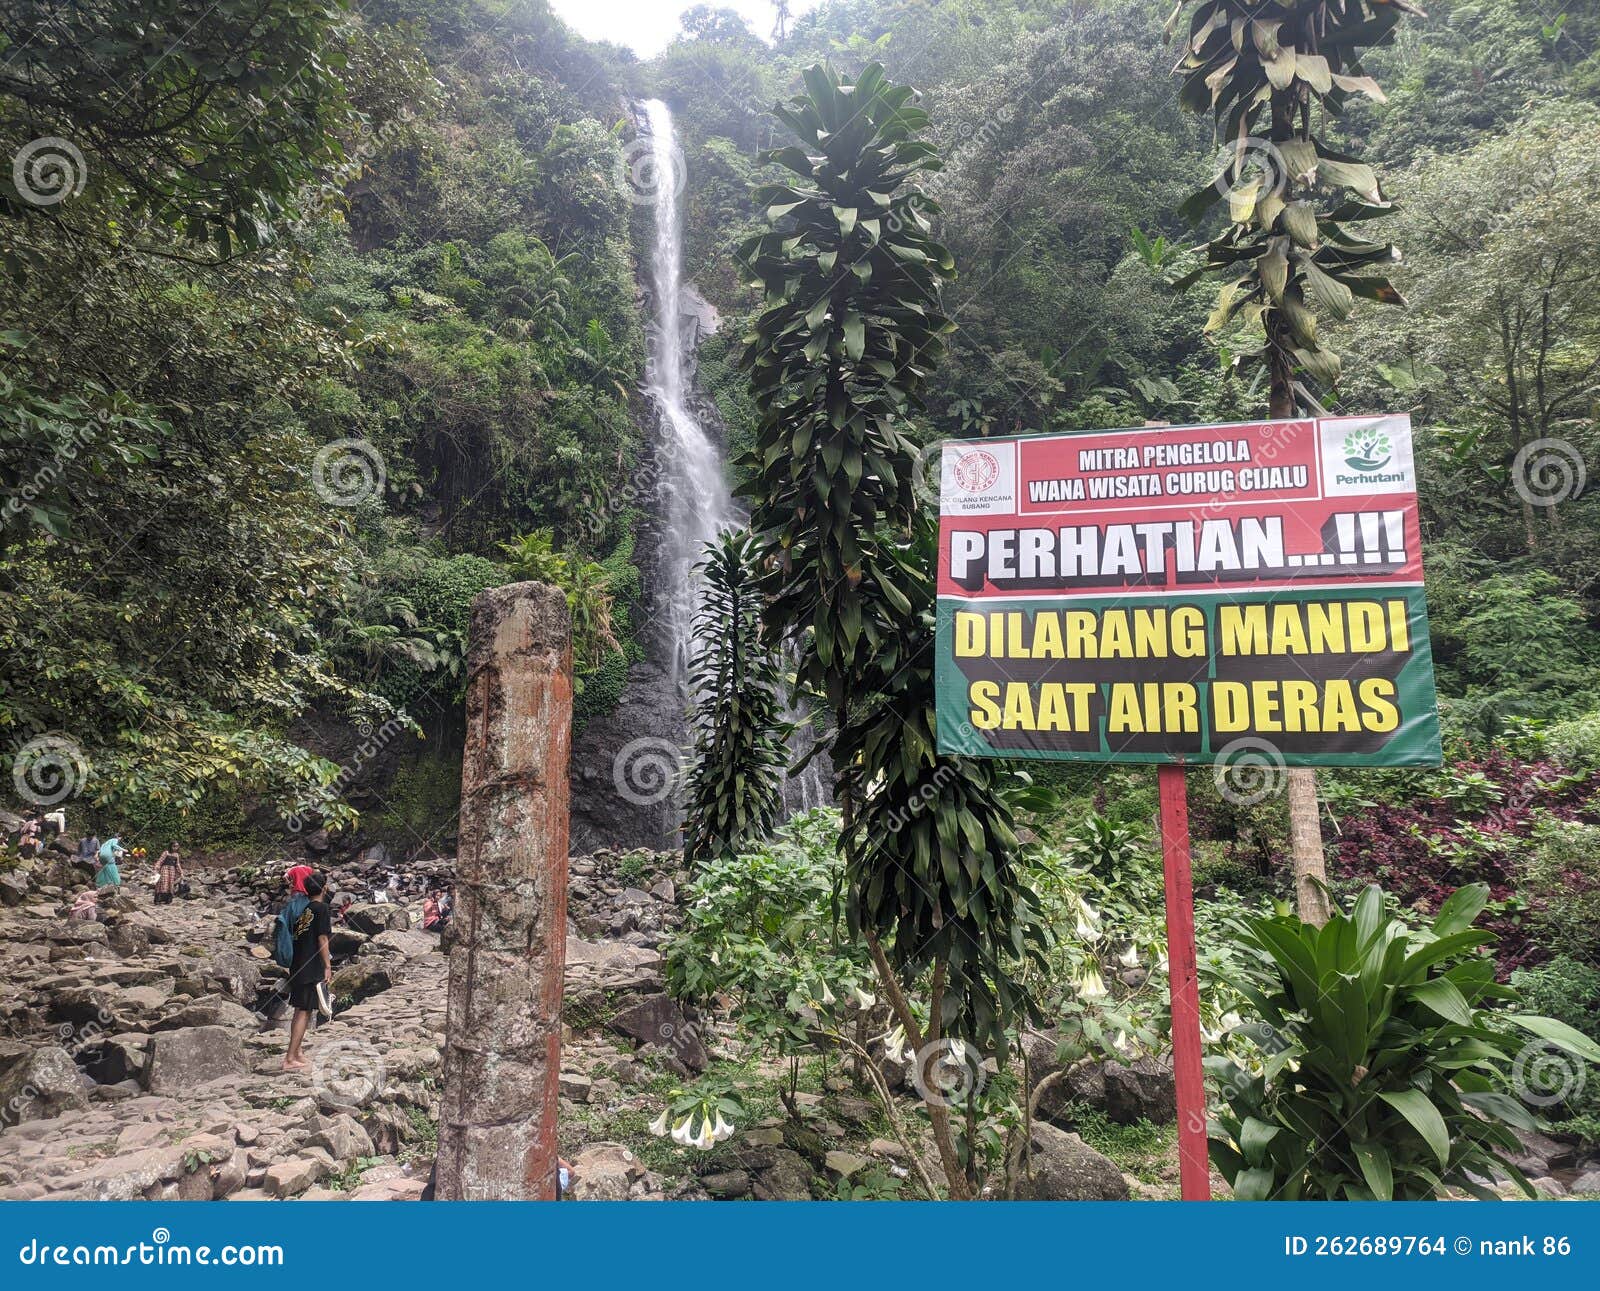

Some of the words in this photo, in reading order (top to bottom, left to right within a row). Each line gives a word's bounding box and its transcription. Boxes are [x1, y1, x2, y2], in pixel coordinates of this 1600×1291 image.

[1079, 447, 1139, 471] MITRA
[1144, 440, 1250, 467] PENGELOLA
[1028, 479, 1086, 503] WANA
[1089, 474, 1162, 499] WISATA
[1166, 470, 1235, 495] CURUG
[1239, 465, 1308, 491] CIJALU
[1336, 472, 1405, 485] Perhutani
[979, 495, 1013, 503] KENCANA
[950, 510, 1407, 579] PERHATIAN...!!!
[954, 606, 1206, 659] DILARANG
[1220, 600, 1410, 656] MANDI
[969, 680, 1097, 733] SAAT
[1108, 682, 1199, 733] AIR
[1212, 677, 1399, 733] DERAS
